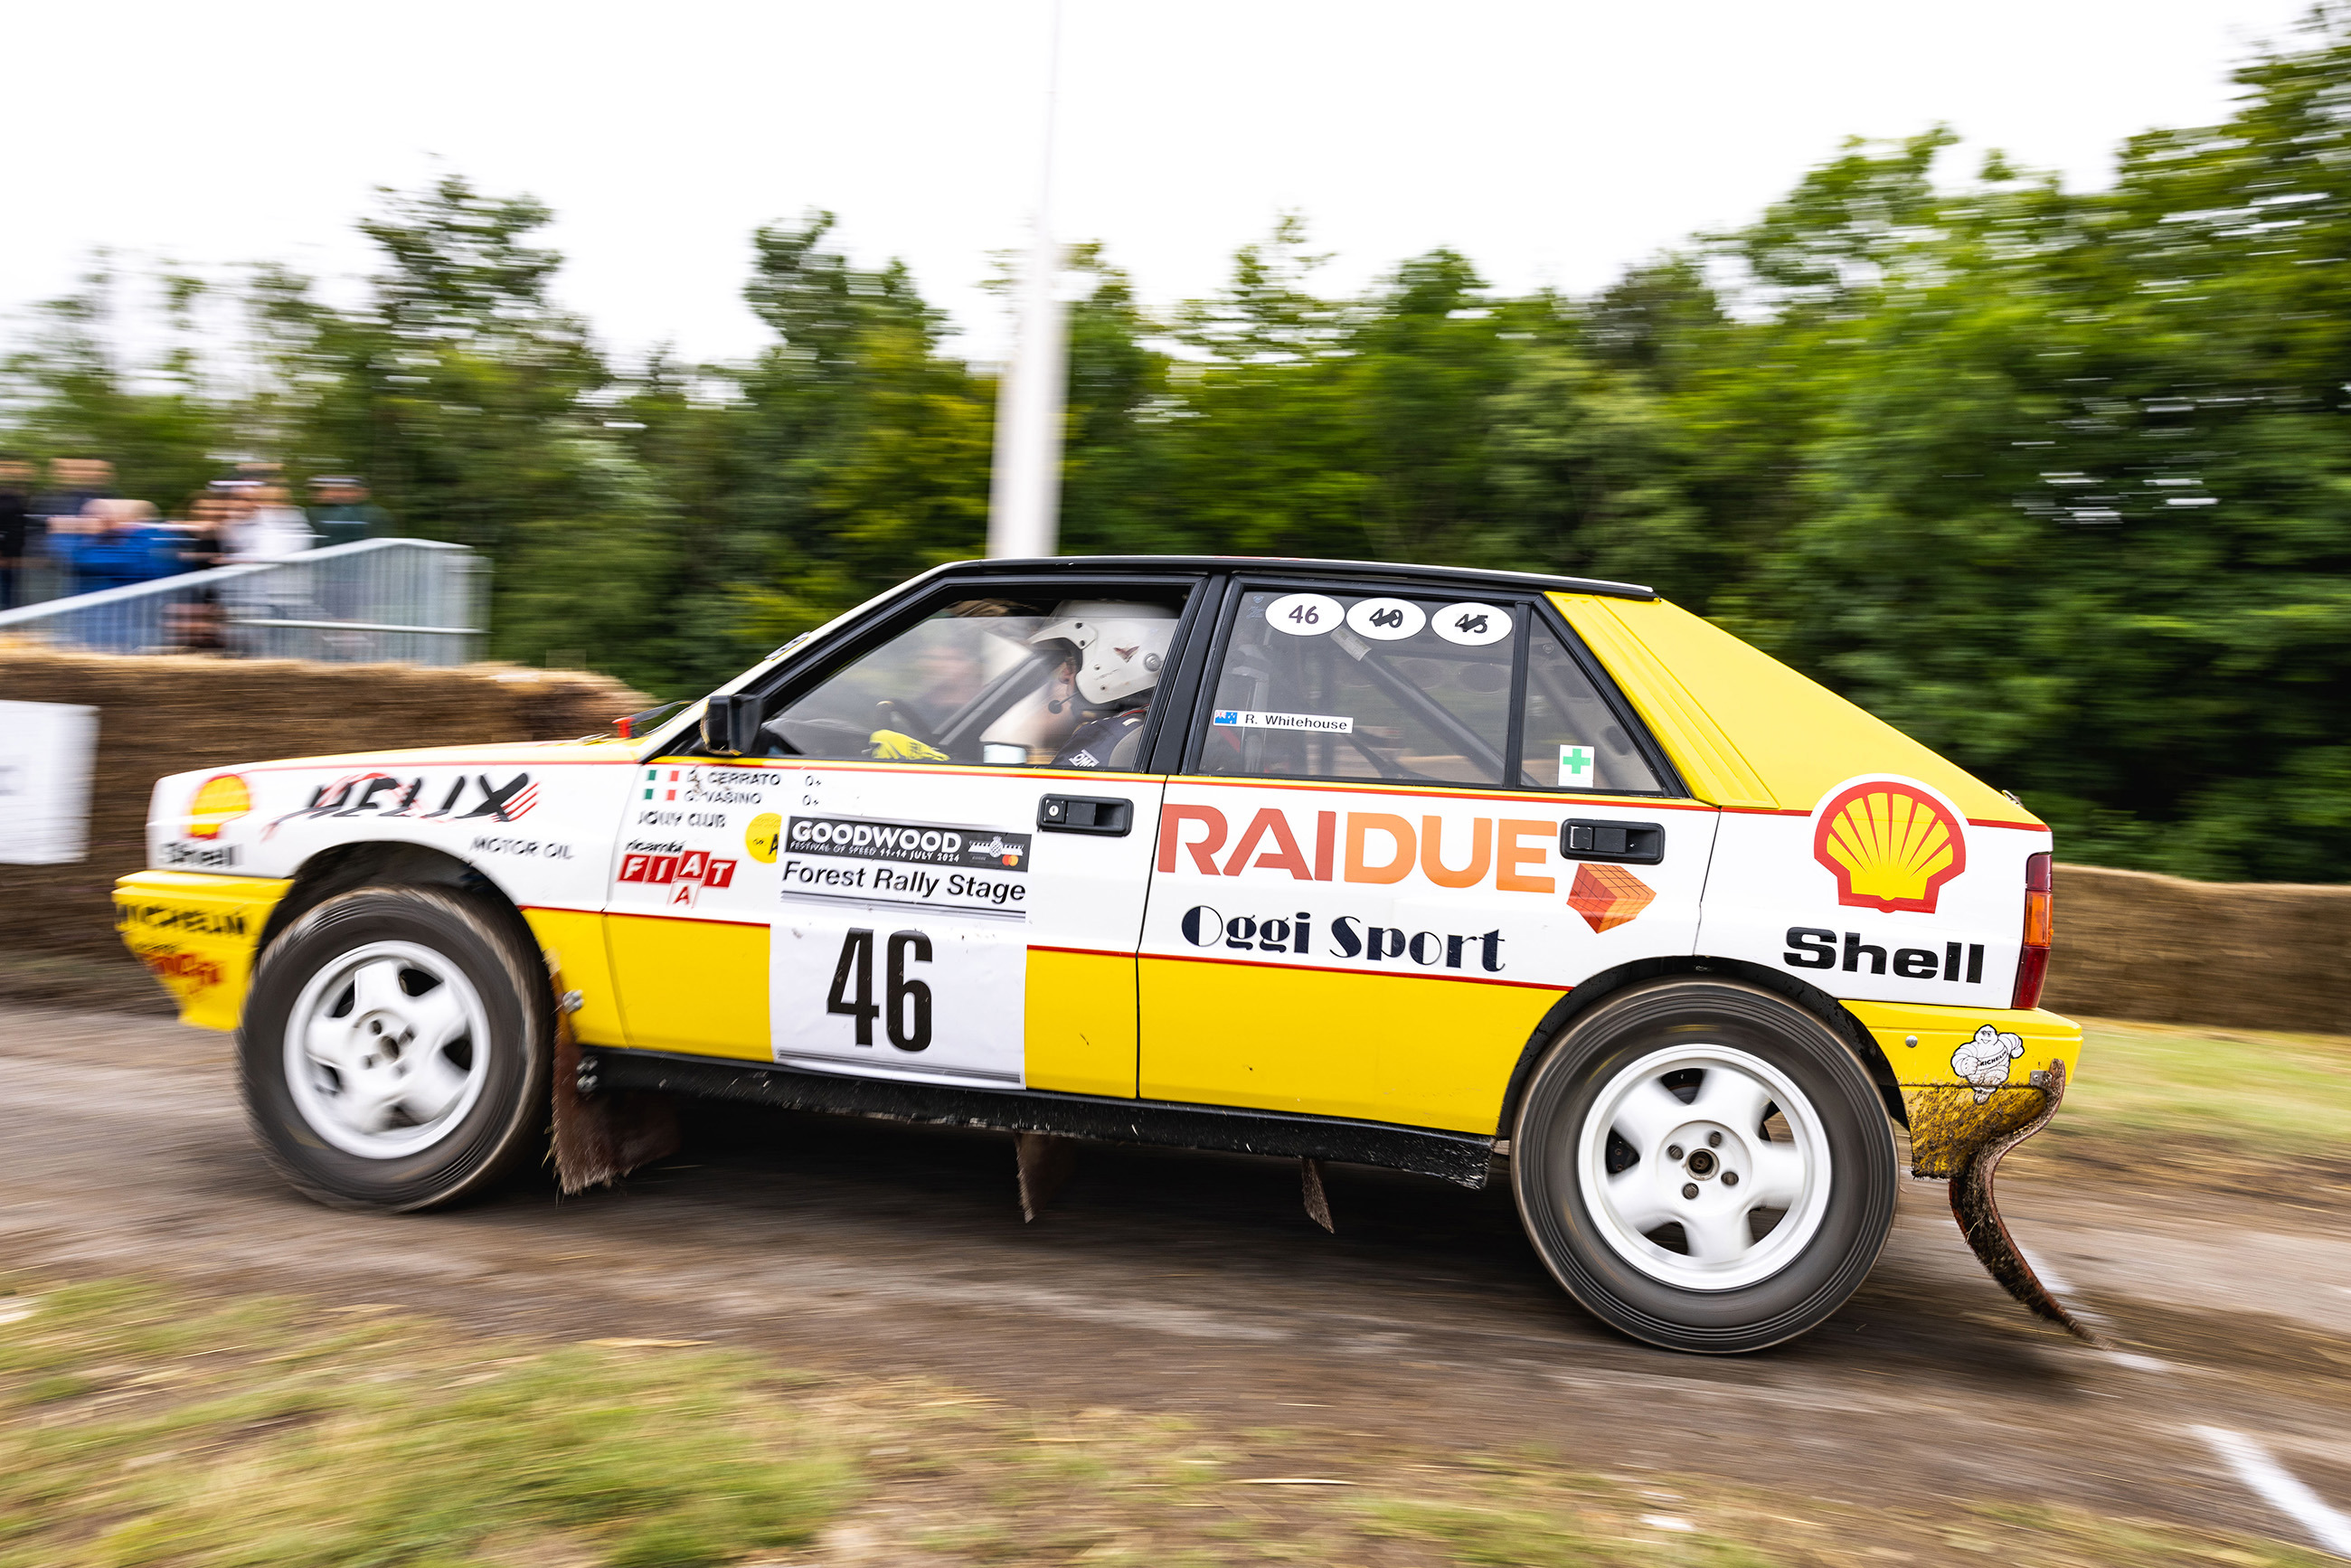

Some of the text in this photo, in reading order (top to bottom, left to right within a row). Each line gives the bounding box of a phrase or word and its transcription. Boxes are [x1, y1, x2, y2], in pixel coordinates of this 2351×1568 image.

[1289, 604, 1319, 625] 46
[1244, 713, 1347, 731] R. Whitehouse
[708, 770, 781, 786] CERRATO
[294, 771, 530, 823] HELIX
[470, 836, 574, 860] MOTOR OIL
[789, 841, 831, 853] FESTIVAL
[833, 844, 846, 854] OF
[848, 845, 877, 856] SPEED
[909, 850, 934, 861] JULY
[936, 852, 960, 863] 2024
[792, 820, 962, 854] GOODWOOD
[1157, 803, 1558, 894] RAIDUE
[623, 853, 732, 885] FIAT
[782, 861, 1026, 904] Forest Rally Stage
[1181, 905, 1506, 973] Oggi Sport
[1783, 926, 1985, 985] Shell
[826, 927, 933, 1053] 46
[1979, 1049, 2006, 1067] MICHELIN
